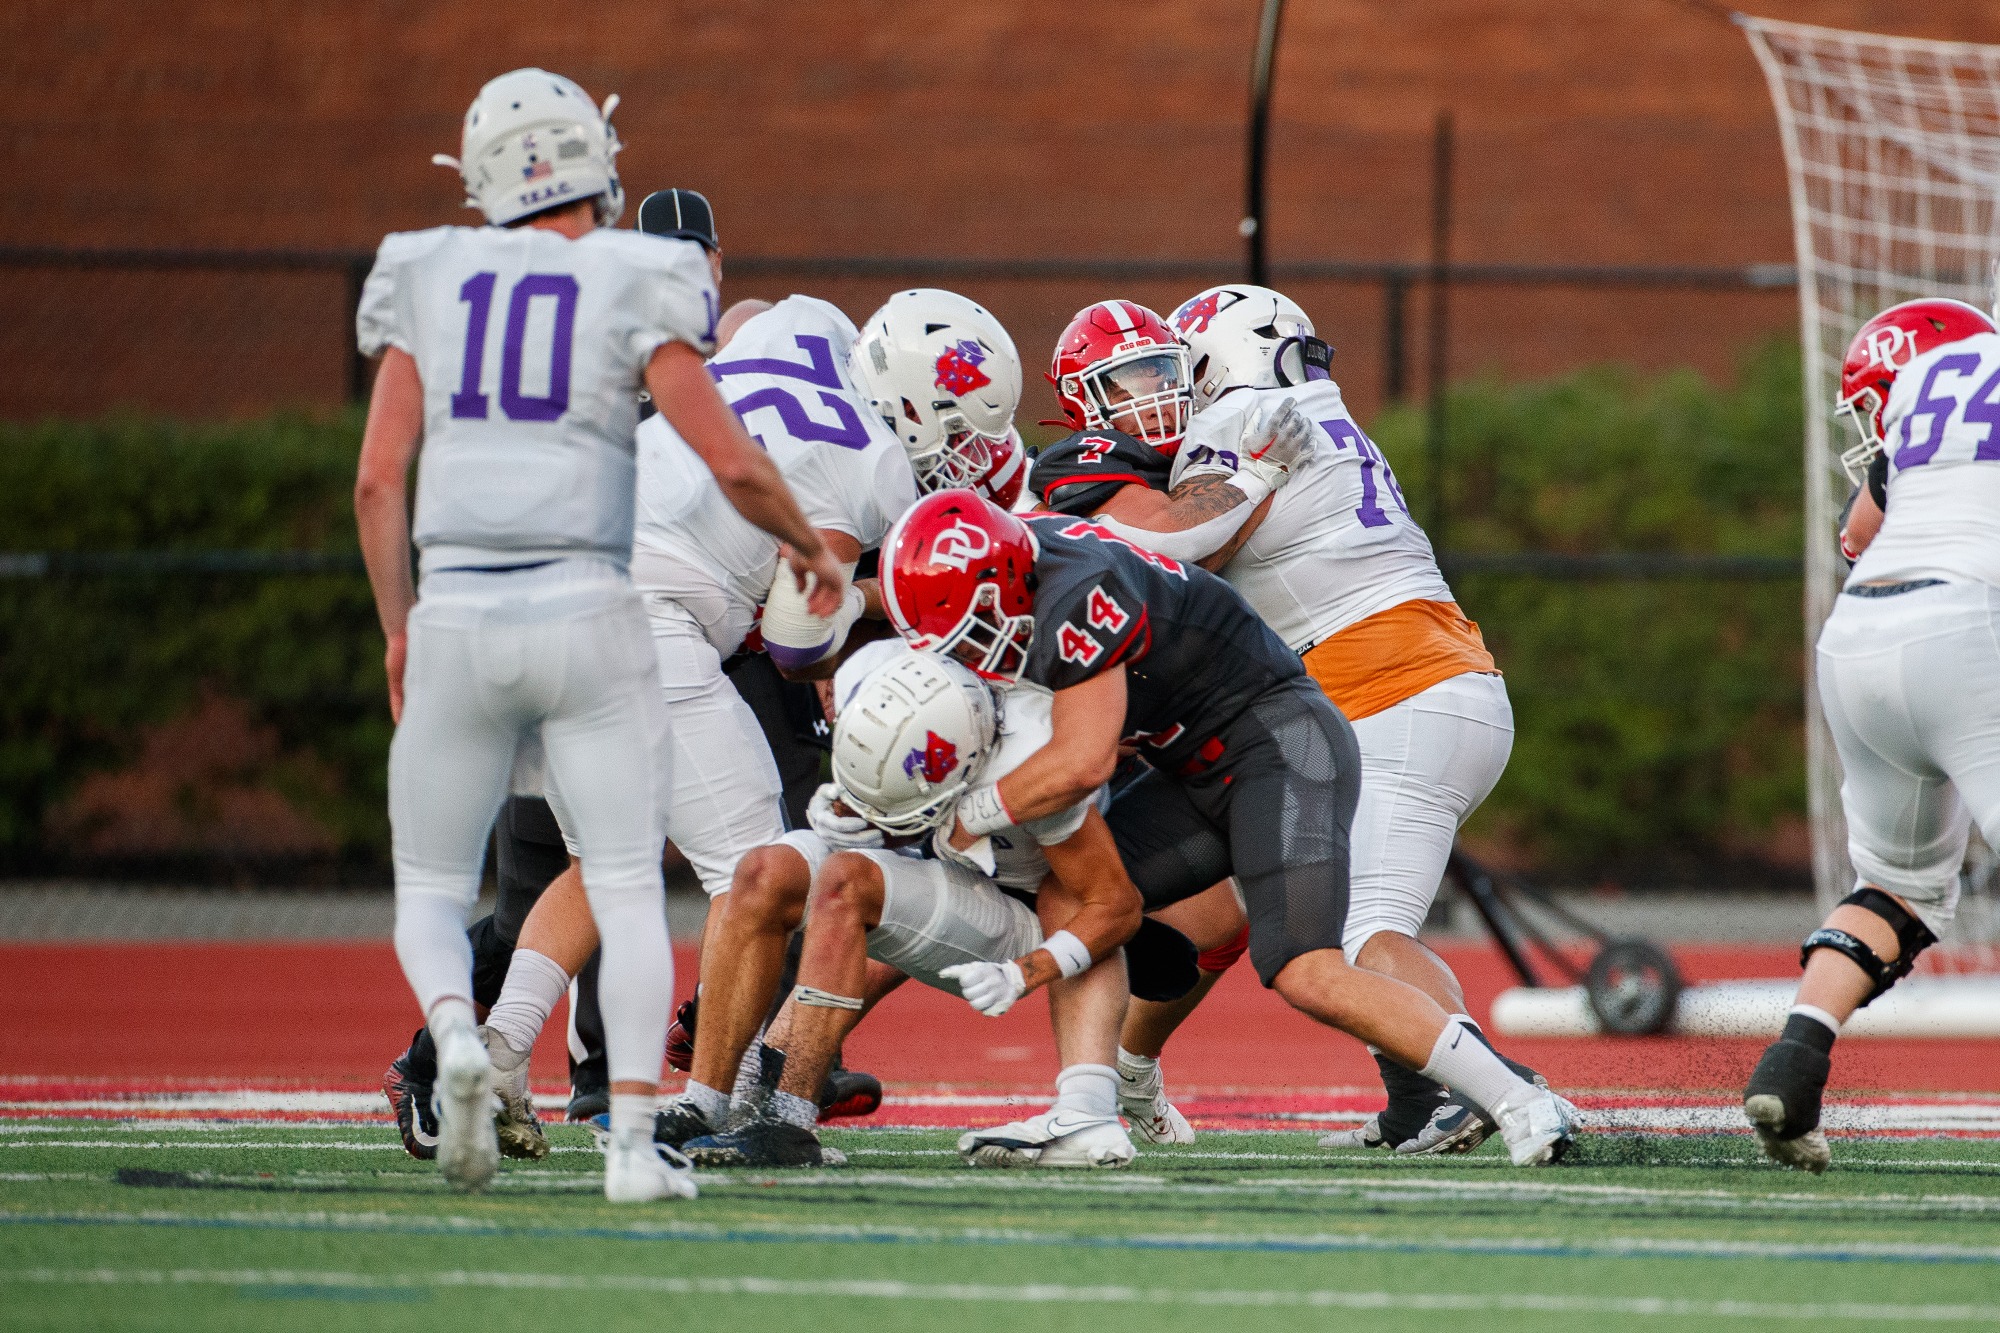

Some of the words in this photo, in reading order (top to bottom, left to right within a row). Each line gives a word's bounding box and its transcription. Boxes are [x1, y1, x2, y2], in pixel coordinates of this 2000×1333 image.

[452, 271, 580, 422] 10
[1120, 342, 1135, 351] BIG
[1135, 338, 1151, 347] RED
[704, 334, 872, 451] 72
[1078, 436, 1117, 464] 7
[1056, 585, 1130, 667] 44
